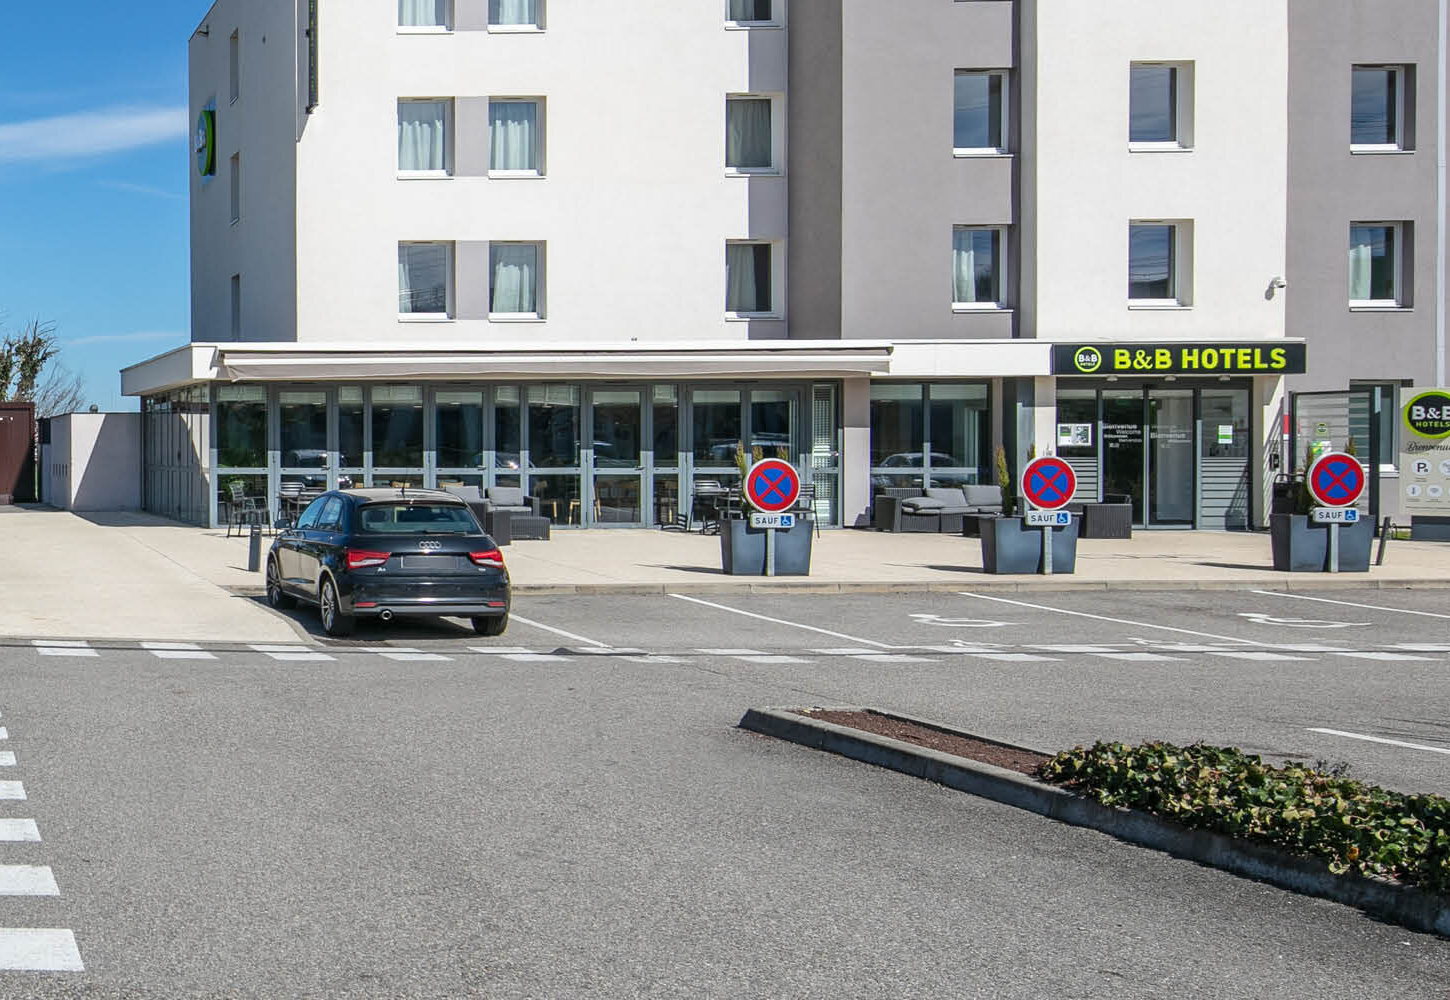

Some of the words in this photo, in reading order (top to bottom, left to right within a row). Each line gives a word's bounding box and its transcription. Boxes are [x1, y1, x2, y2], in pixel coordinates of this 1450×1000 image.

[1078, 353, 1098, 363] B&B
[1114, 348, 1173, 370] B&B
[1181, 348, 1287, 370] HOTELS
[1406, 440, 1450, 454] Bienvenu
[1030, 514, 1055, 522] SAUF
[1318, 511, 1343, 519] SAUF
[755, 517, 779, 525] SAUF
